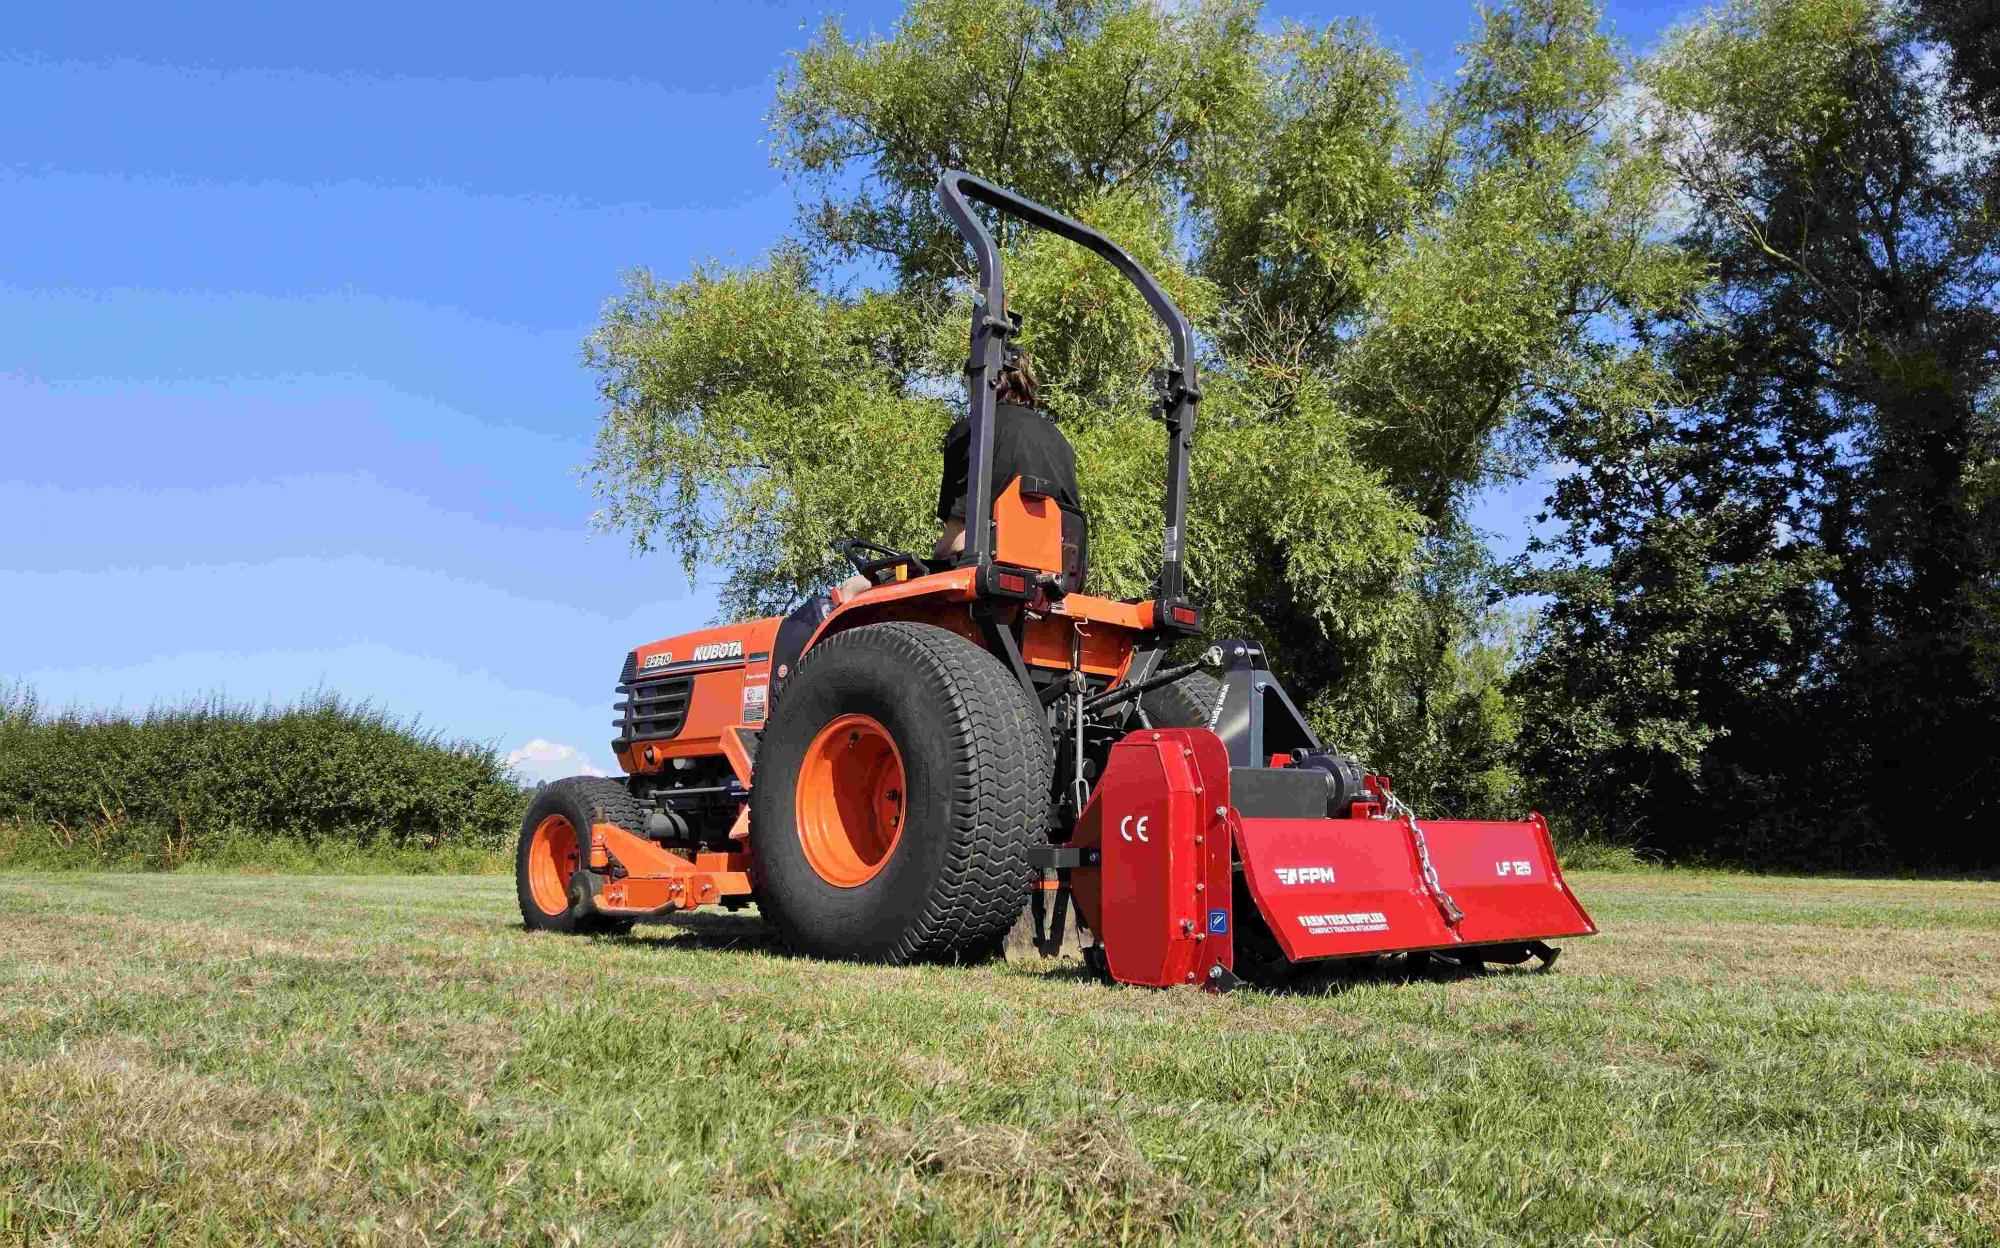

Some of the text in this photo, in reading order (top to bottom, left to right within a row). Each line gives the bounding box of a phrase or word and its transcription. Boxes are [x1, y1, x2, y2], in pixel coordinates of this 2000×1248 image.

[692, 641, 742, 661] KUBOTA
[644, 652, 672, 668] B2710
[1120, 815, 1149, 842] CE
[1298, 867, 1336, 885] FPM
[1495, 861, 1532, 876] LF 125
[1297, 915, 1327, 927] FARM
[1323, 914, 1350, 926] TECH
